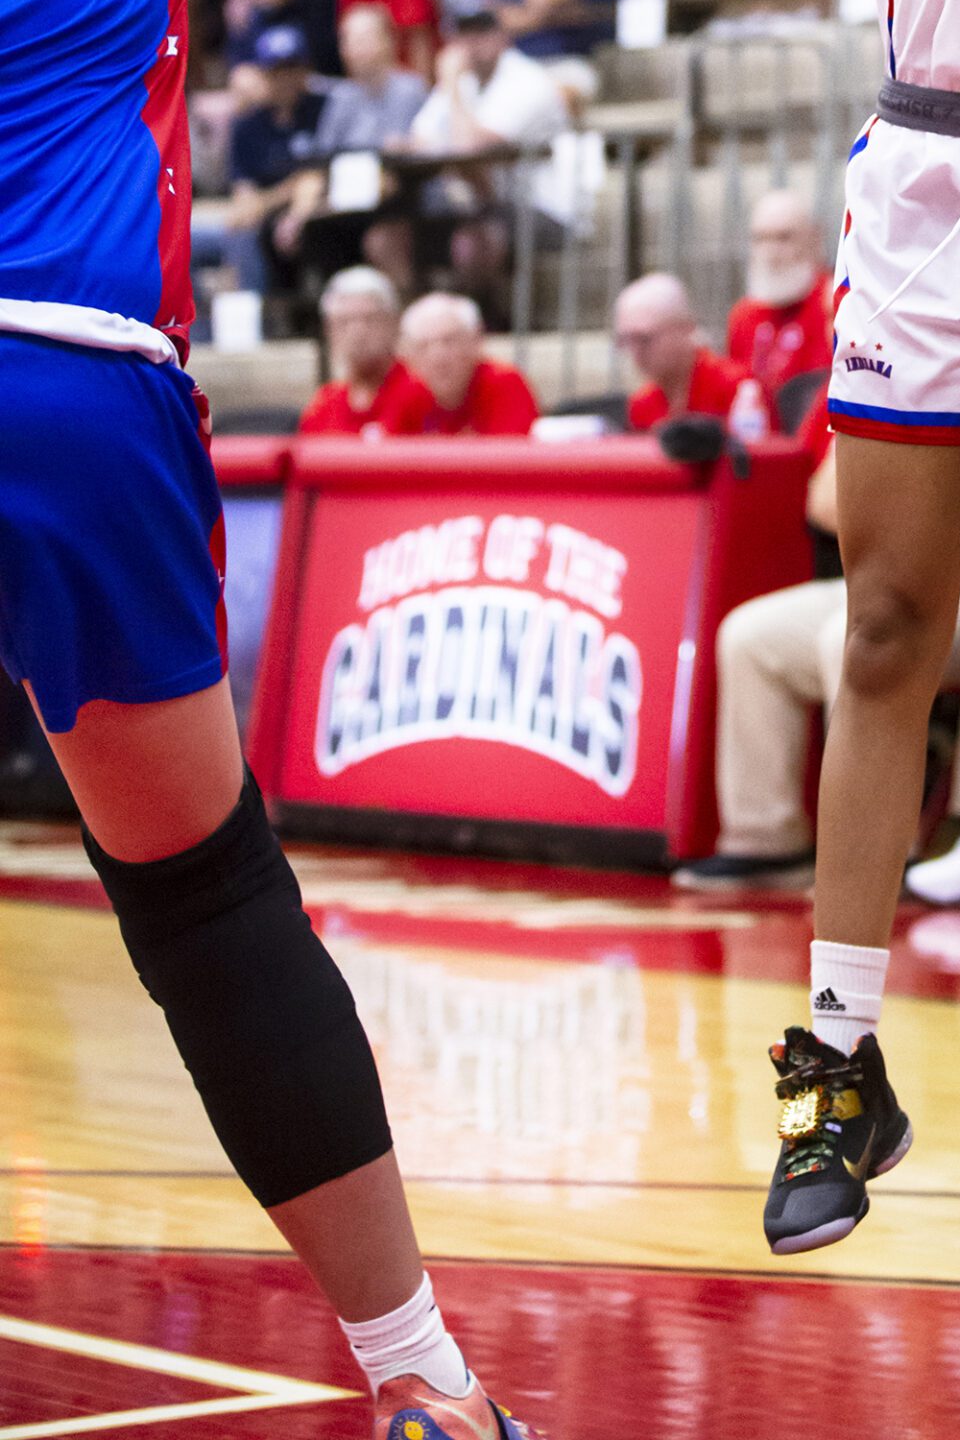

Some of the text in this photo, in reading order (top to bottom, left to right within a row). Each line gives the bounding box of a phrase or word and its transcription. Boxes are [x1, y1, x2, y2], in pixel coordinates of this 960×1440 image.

[845, 356, 893, 379] INDIANA
[358, 514, 627, 619] HOME OF THE
[317, 588, 642, 797] CARDINALS
